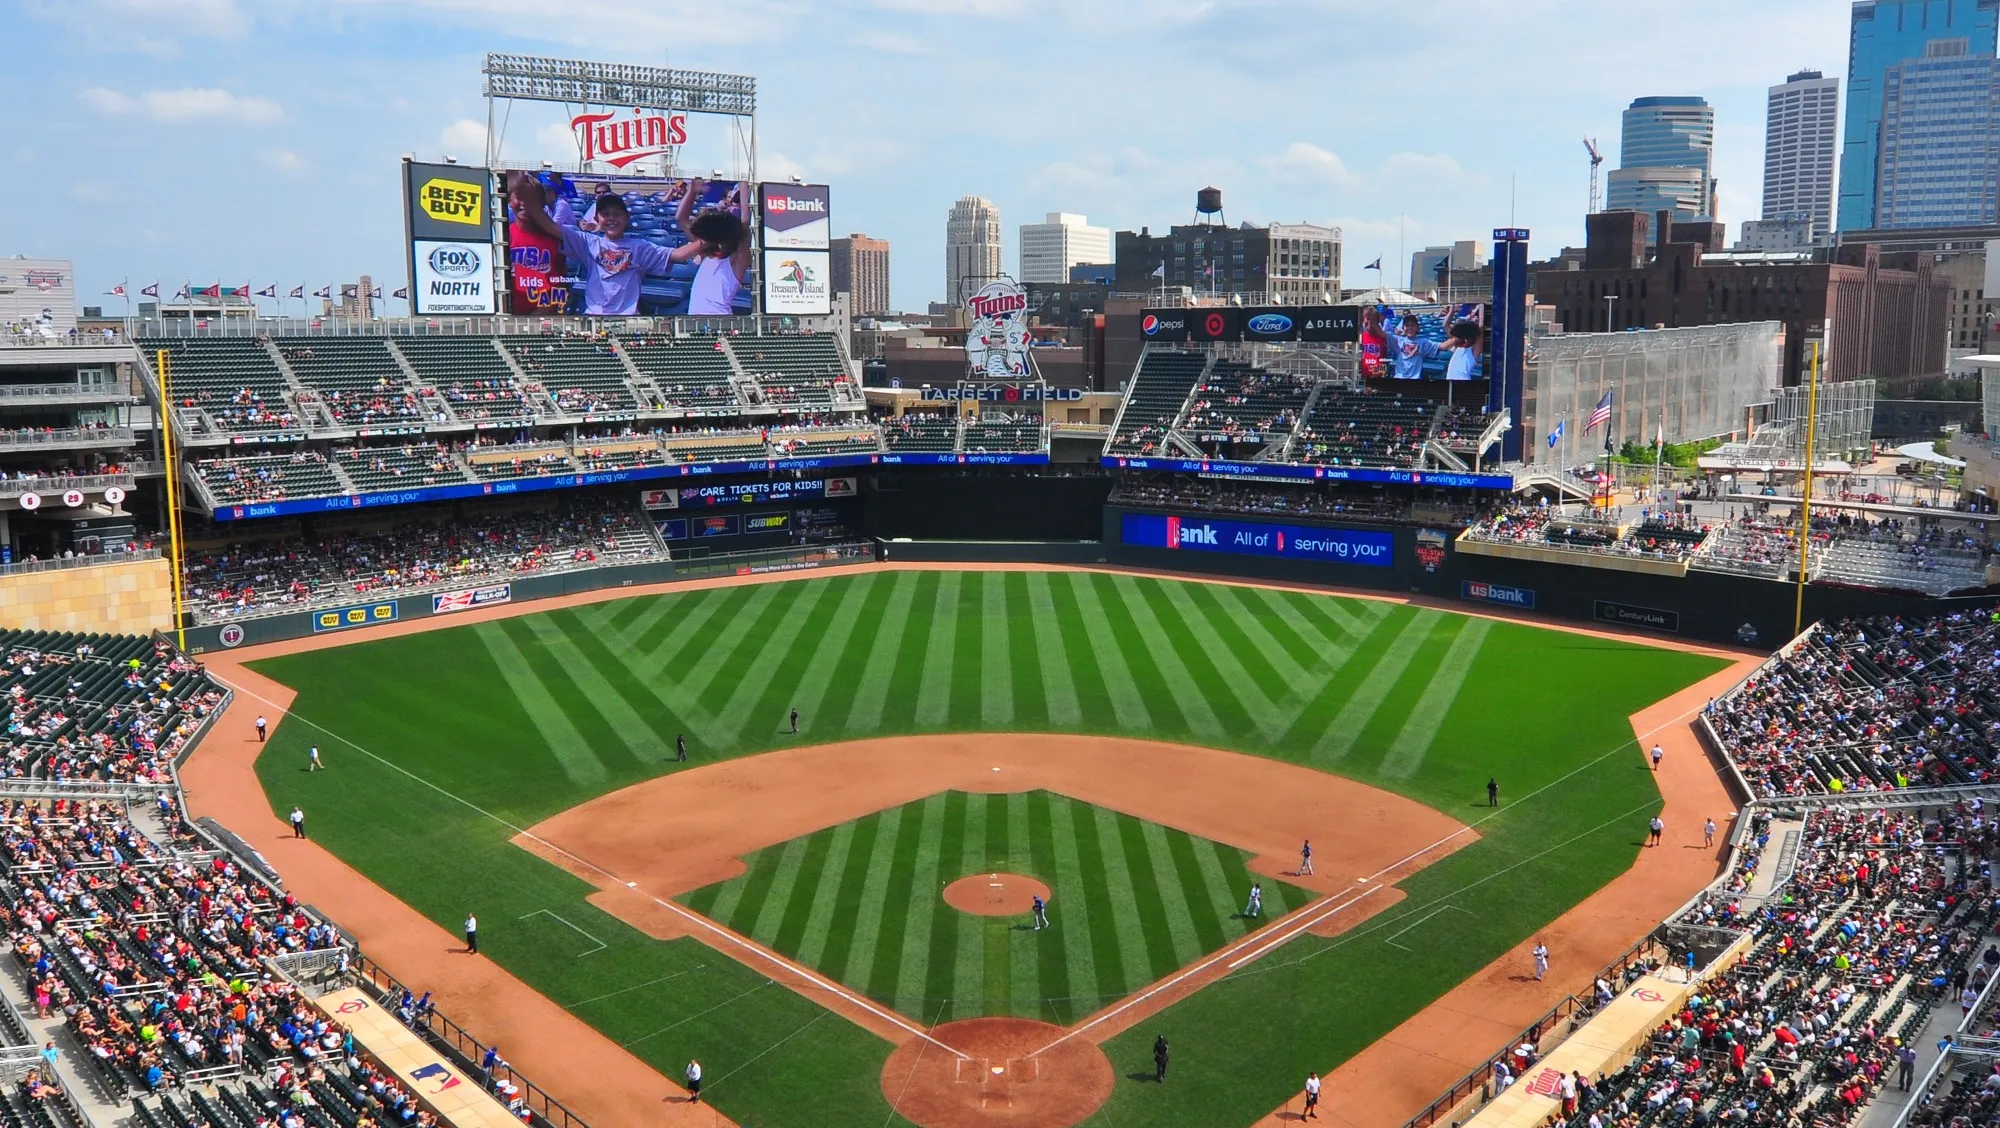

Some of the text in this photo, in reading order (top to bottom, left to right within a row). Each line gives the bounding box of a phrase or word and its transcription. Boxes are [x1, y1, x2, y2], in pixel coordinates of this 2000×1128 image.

[571, 107, 687, 163] Twins
[428, 185, 480, 205] BEST
[430, 200, 475, 217] BUY
[439, 251, 469, 265] FOX
[520, 276, 544, 287] kids
[770, 282, 824, 293] Treasure Island
[430, 280, 480, 296] NORTH
[968, 292, 1026, 320] Twins
[1159, 318, 1184, 330] pepsi
[1256, 316, 1284, 331] Ford
[1317, 320, 1354, 328] DELTA
[921, 389, 1083, 400] TARGET FIELD
[882, 454, 902, 463] bank
[938, 454, 948, 462] All
[949, 454, 956, 462] of
[968, 455, 995, 464] serving
[1130, 460, 1148, 468] bank
[693, 465, 712, 474] bank
[749, 462, 759, 470] All
[760, 460, 766, 469] of
[779, 460, 804, 470] serving
[1183, 462, 1192, 470] All
[1192, 462, 1200, 470] of
[1212, 464, 1239, 474] serving
[555, 477, 566, 486] All
[566, 476, 574, 484] of
[586, 474, 612, 484] serving
[1328, 470, 1348, 478] bank
[1390, 472, 1400, 480] All
[1402, 472, 1410, 480] of
[1426, 474, 1456, 485] serving
[496, 483, 516, 492] bank
[700, 480, 823, 496] CARE TICKETS FOR KIDS!!
[326, 498, 339, 508] All
[340, 498, 350, 507] of
[366, 494, 398, 505] serving
[250, 506, 276, 516] bank
[748, 516, 788, 528] SUBWAY
[1234, 531, 1252, 546] All
[1254, 533, 1268, 546] of
[1294, 538, 1348, 556] serving
[475, 590, 508, 601] WALK-OFF
[1618, 610, 1665, 624] CenturyLink
